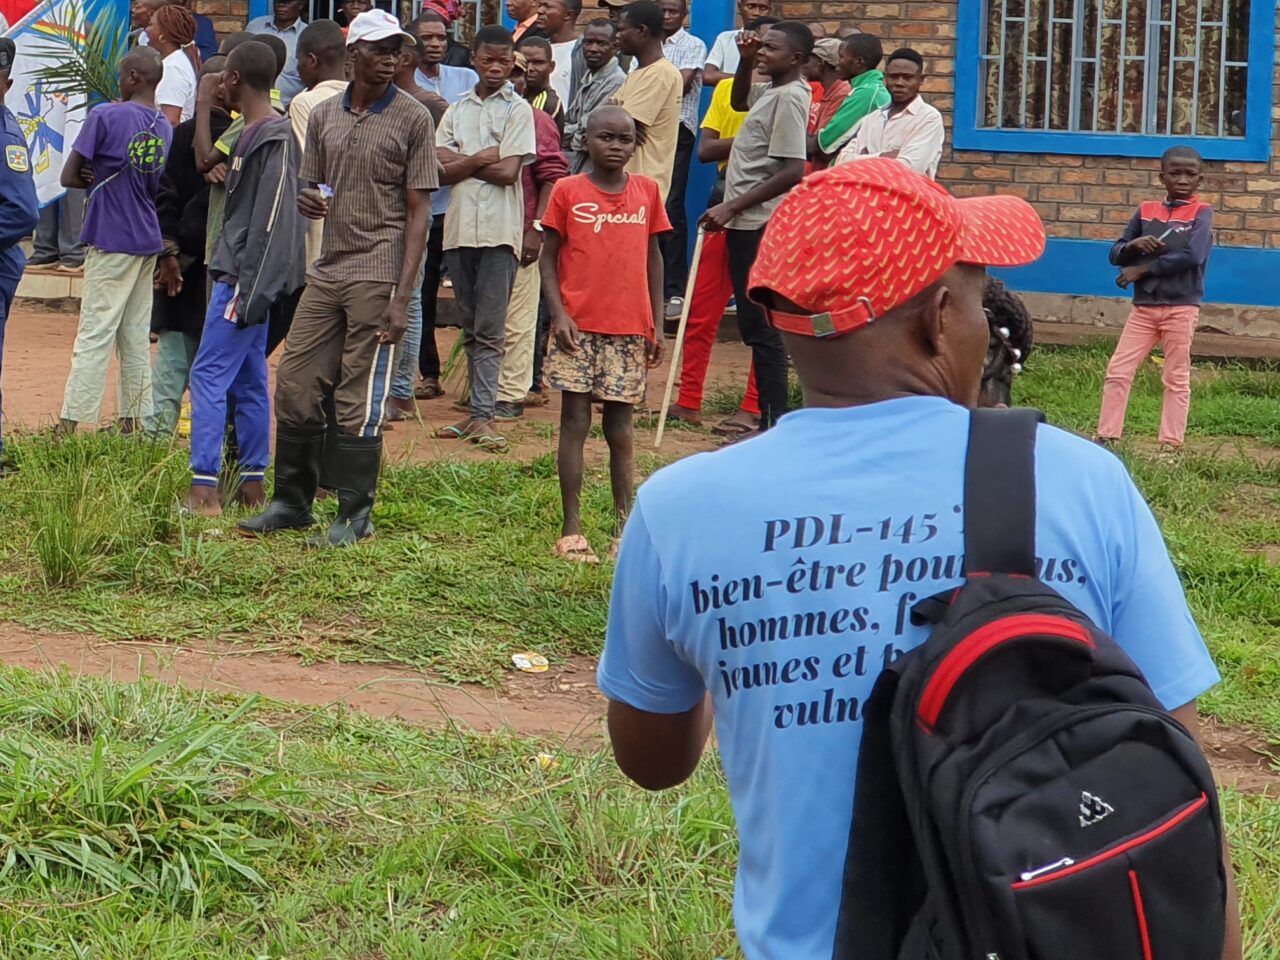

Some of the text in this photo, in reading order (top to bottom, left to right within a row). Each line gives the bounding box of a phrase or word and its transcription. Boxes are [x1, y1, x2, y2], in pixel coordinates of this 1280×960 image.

[572, 202, 646, 233] Special
[761, 513, 938, 553] PDL-145
[689, 555, 866, 616] bien-être
[717, 606, 880, 651] hommes,
[718, 655, 820, 699] jeunes
[832, 645, 869, 678] et
